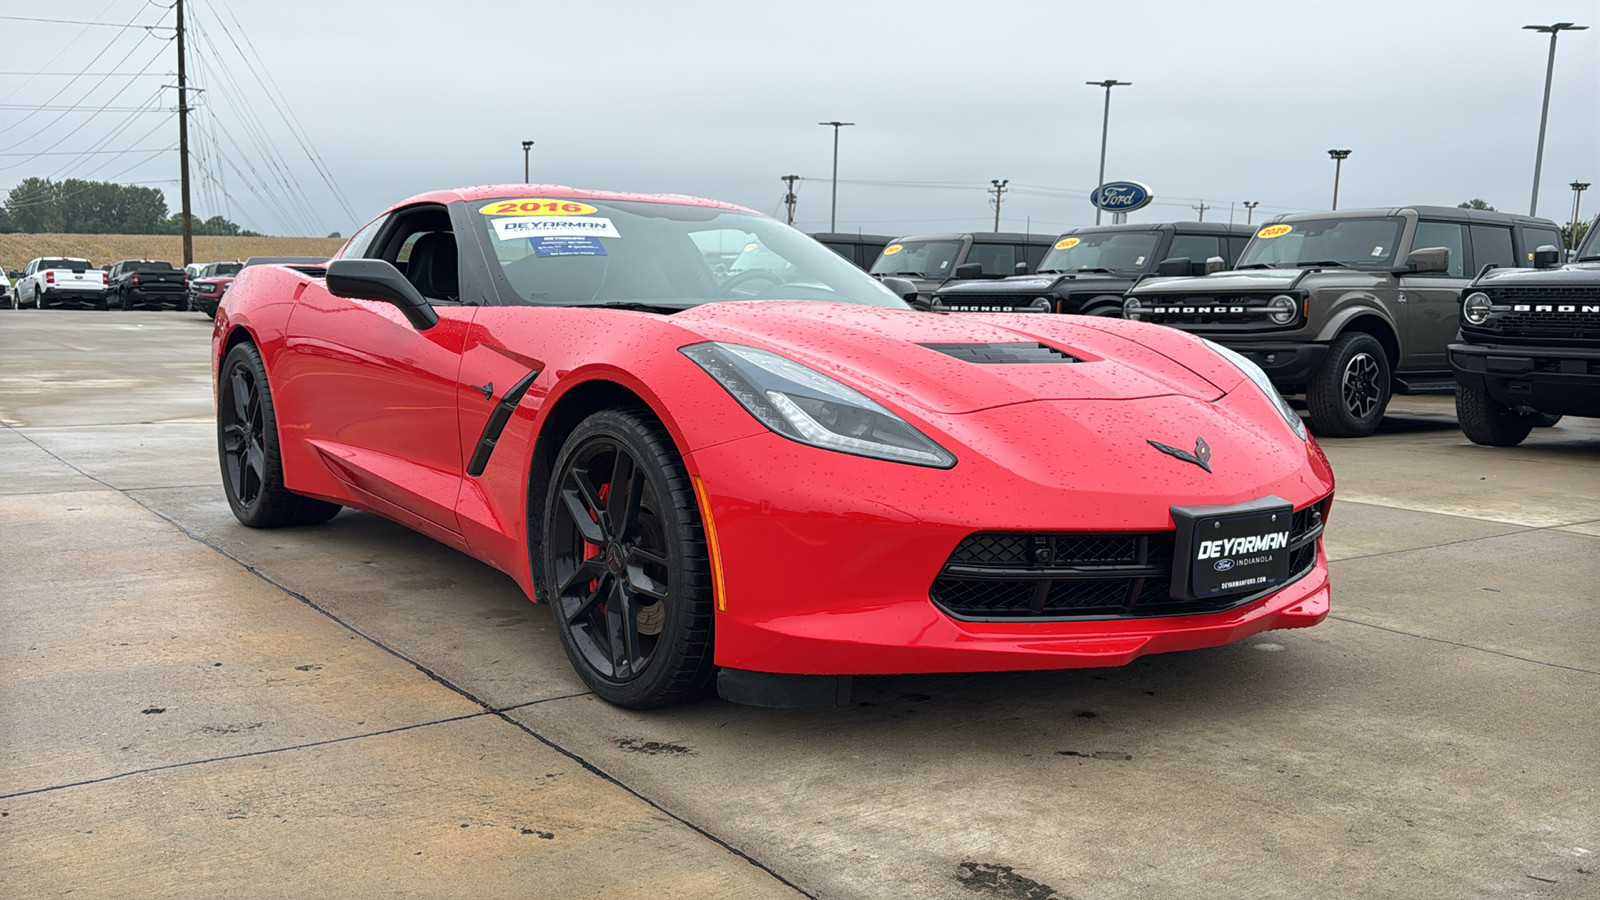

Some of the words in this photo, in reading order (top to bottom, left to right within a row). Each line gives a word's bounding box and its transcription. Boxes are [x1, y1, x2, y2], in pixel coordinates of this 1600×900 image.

[1101, 187, 1136, 205] Ford
[495, 203, 583, 214] 2016
[504, 222, 607, 230] DEYARMAN
[1260, 226, 1289, 237] 2026
[1197, 531, 1289, 560] DEYARMAN
[1237, 555, 1273, 566] INDIANOLA
[1222, 577, 1266, 589] DEYARMANFORD.COM
